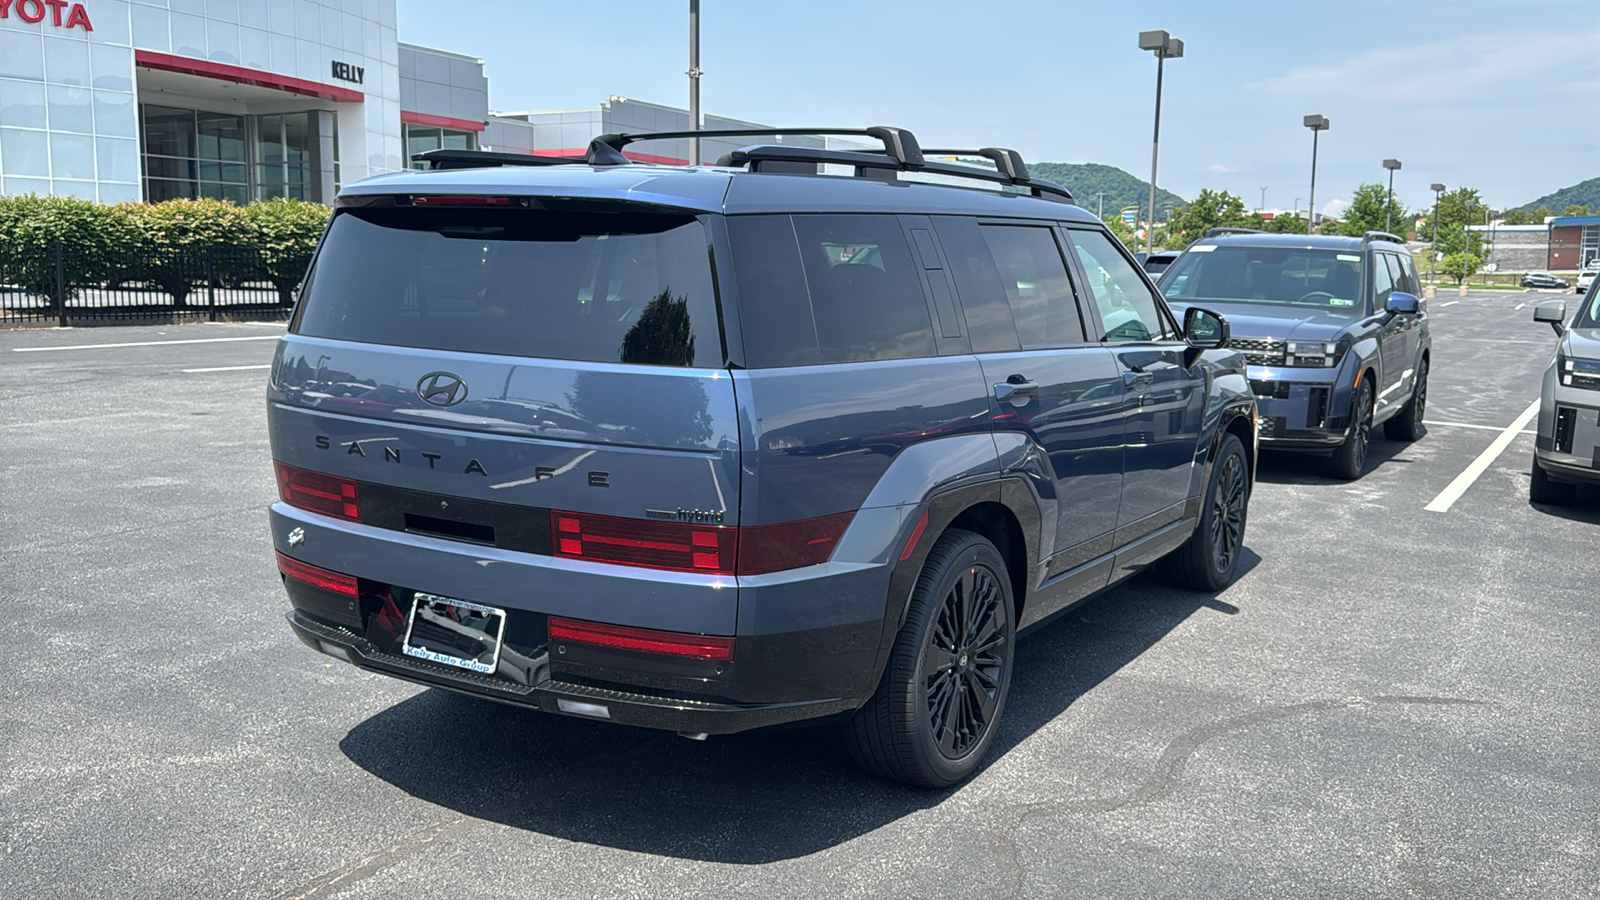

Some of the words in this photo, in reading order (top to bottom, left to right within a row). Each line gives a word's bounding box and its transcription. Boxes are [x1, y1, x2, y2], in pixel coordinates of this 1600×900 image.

[331, 60, 365, 84] KELLY
[315, 435, 488, 476] SANTA
[535, 466, 610, 487] FE
[677, 506, 725, 523] hybrid
[406, 647, 432, 659] Kelly
[433, 653, 457, 665] Auto
[459, 659, 490, 673] Group
